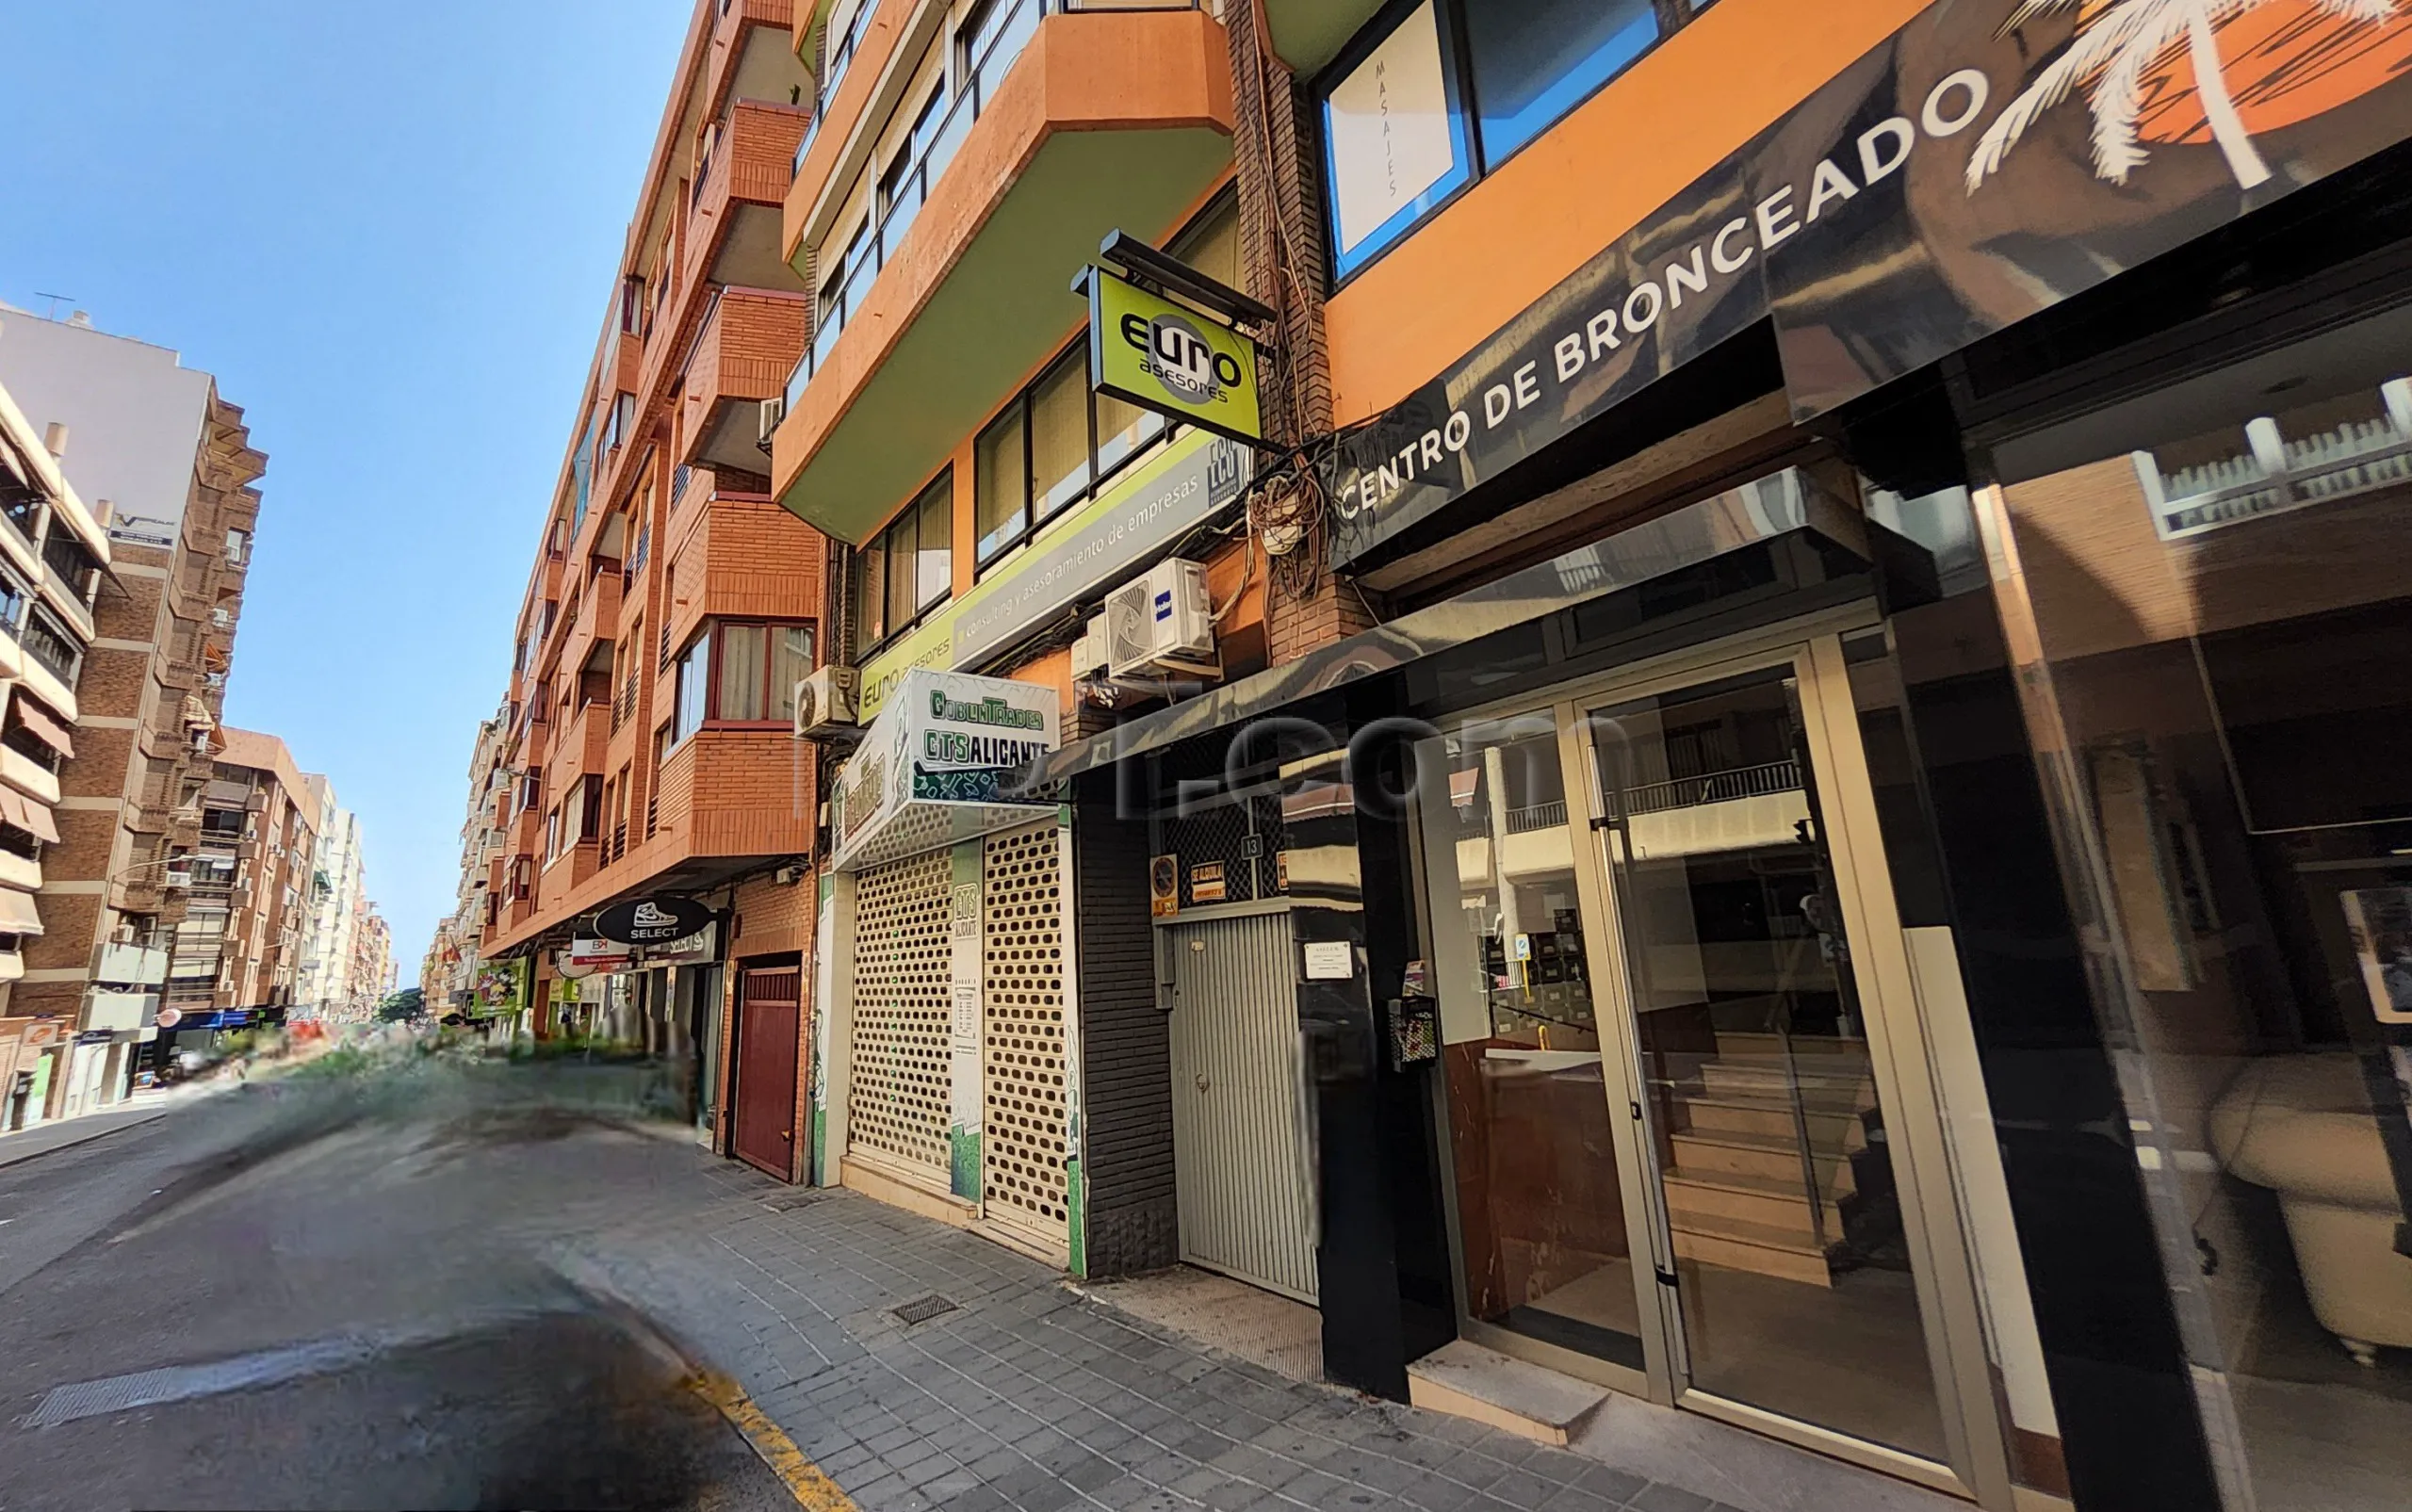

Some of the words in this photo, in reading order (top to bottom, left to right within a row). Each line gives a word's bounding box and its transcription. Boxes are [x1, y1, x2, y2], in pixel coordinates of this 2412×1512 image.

[1376, 59, 1396, 197] MASAJES
[1340, 410, 1471, 520] CENTRO
[1483, 359, 1541, 430] DE
[1554, 68, 1990, 383] BRONCEADO
[966, 598, 1013, 639] consulting
[1014, 591, 1022, 608] y
[1023, 536, 1104, 601] asesoramiento
[1107, 523, 1124, 546] de
[1128, 474, 1199, 533] empresas
[1246, 838, 1258, 854] 13
[630, 928, 678, 939] SELECT
